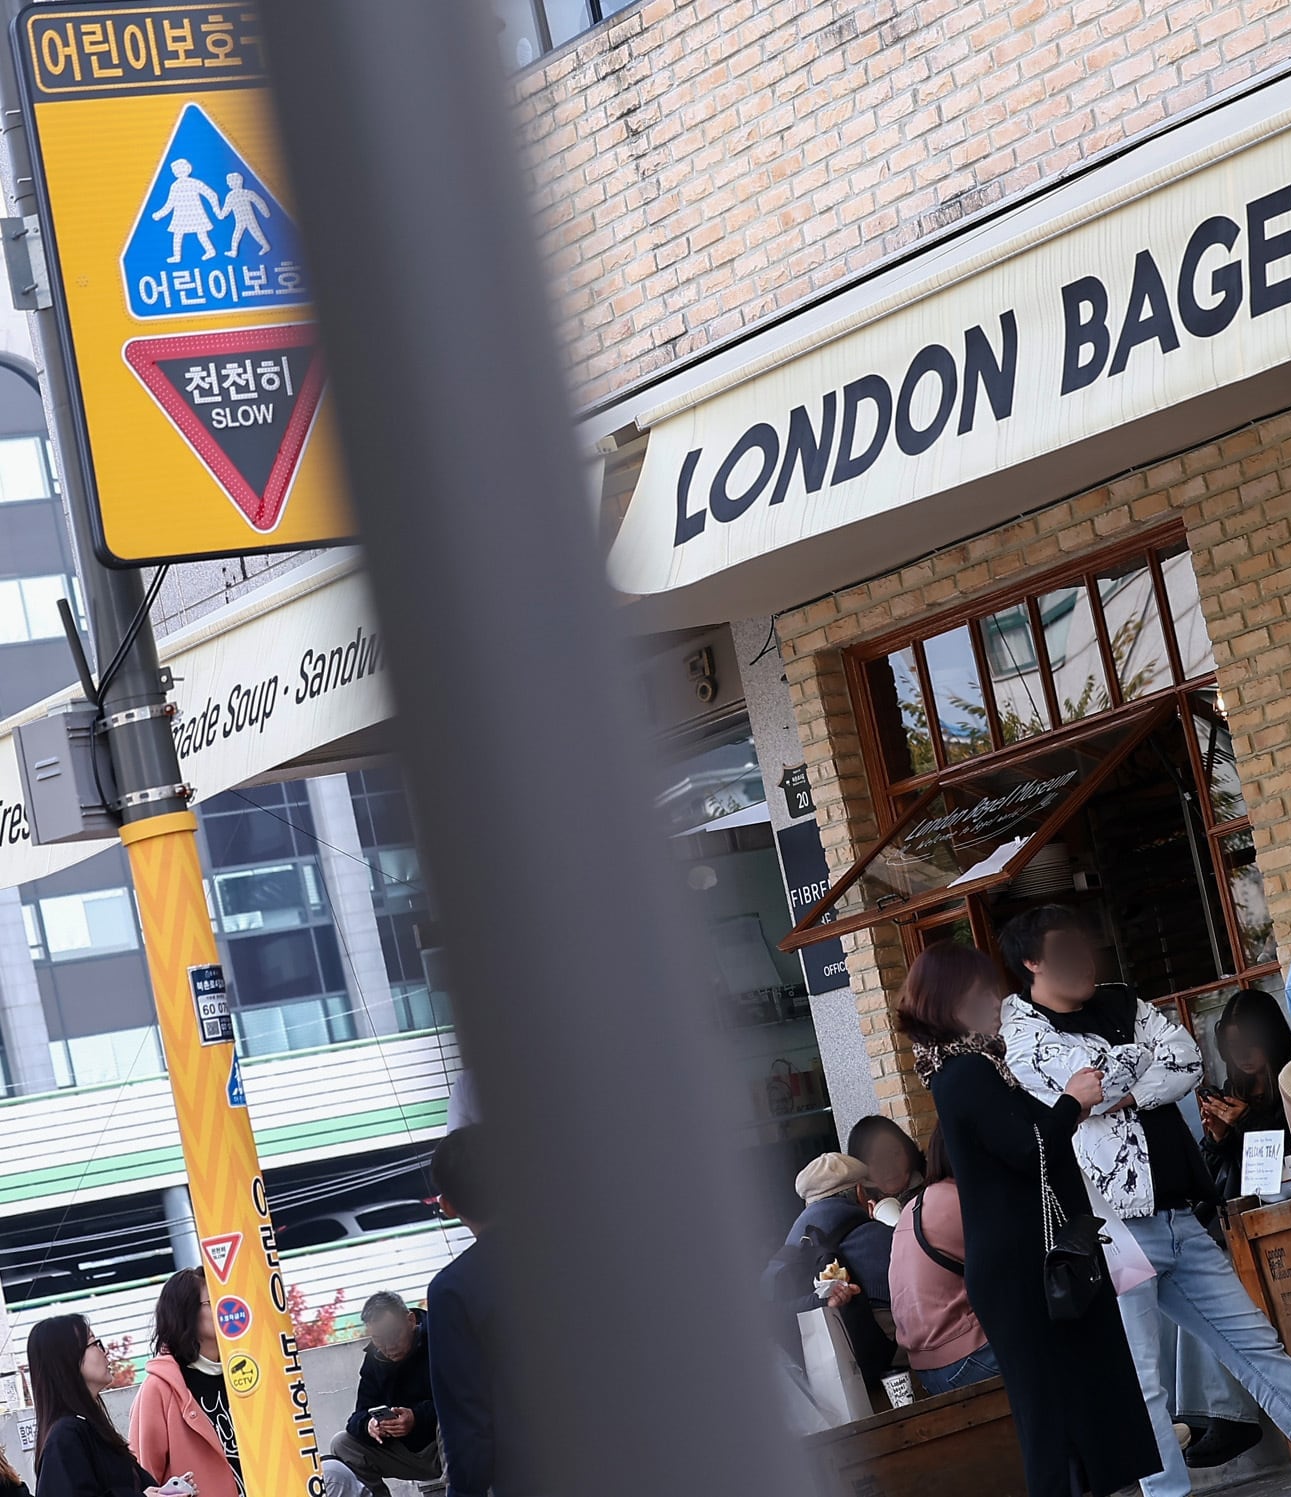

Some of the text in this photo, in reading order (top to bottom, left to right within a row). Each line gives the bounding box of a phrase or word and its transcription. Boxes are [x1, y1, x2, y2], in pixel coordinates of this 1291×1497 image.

[138, 260, 306, 308] 어린이보호
[184, 356, 294, 404] 천천히
[211, 403, 274, 429] SLOW
[673, 309, 1018, 548] LONDON
[222, 675, 279, 739] Soup
[796, 791, 809, 809] 20
[823, 961, 848, 978] OFFIC
[202, 1004, 216, 1017] 60
[233, 1376, 254, 1388] CCTV
